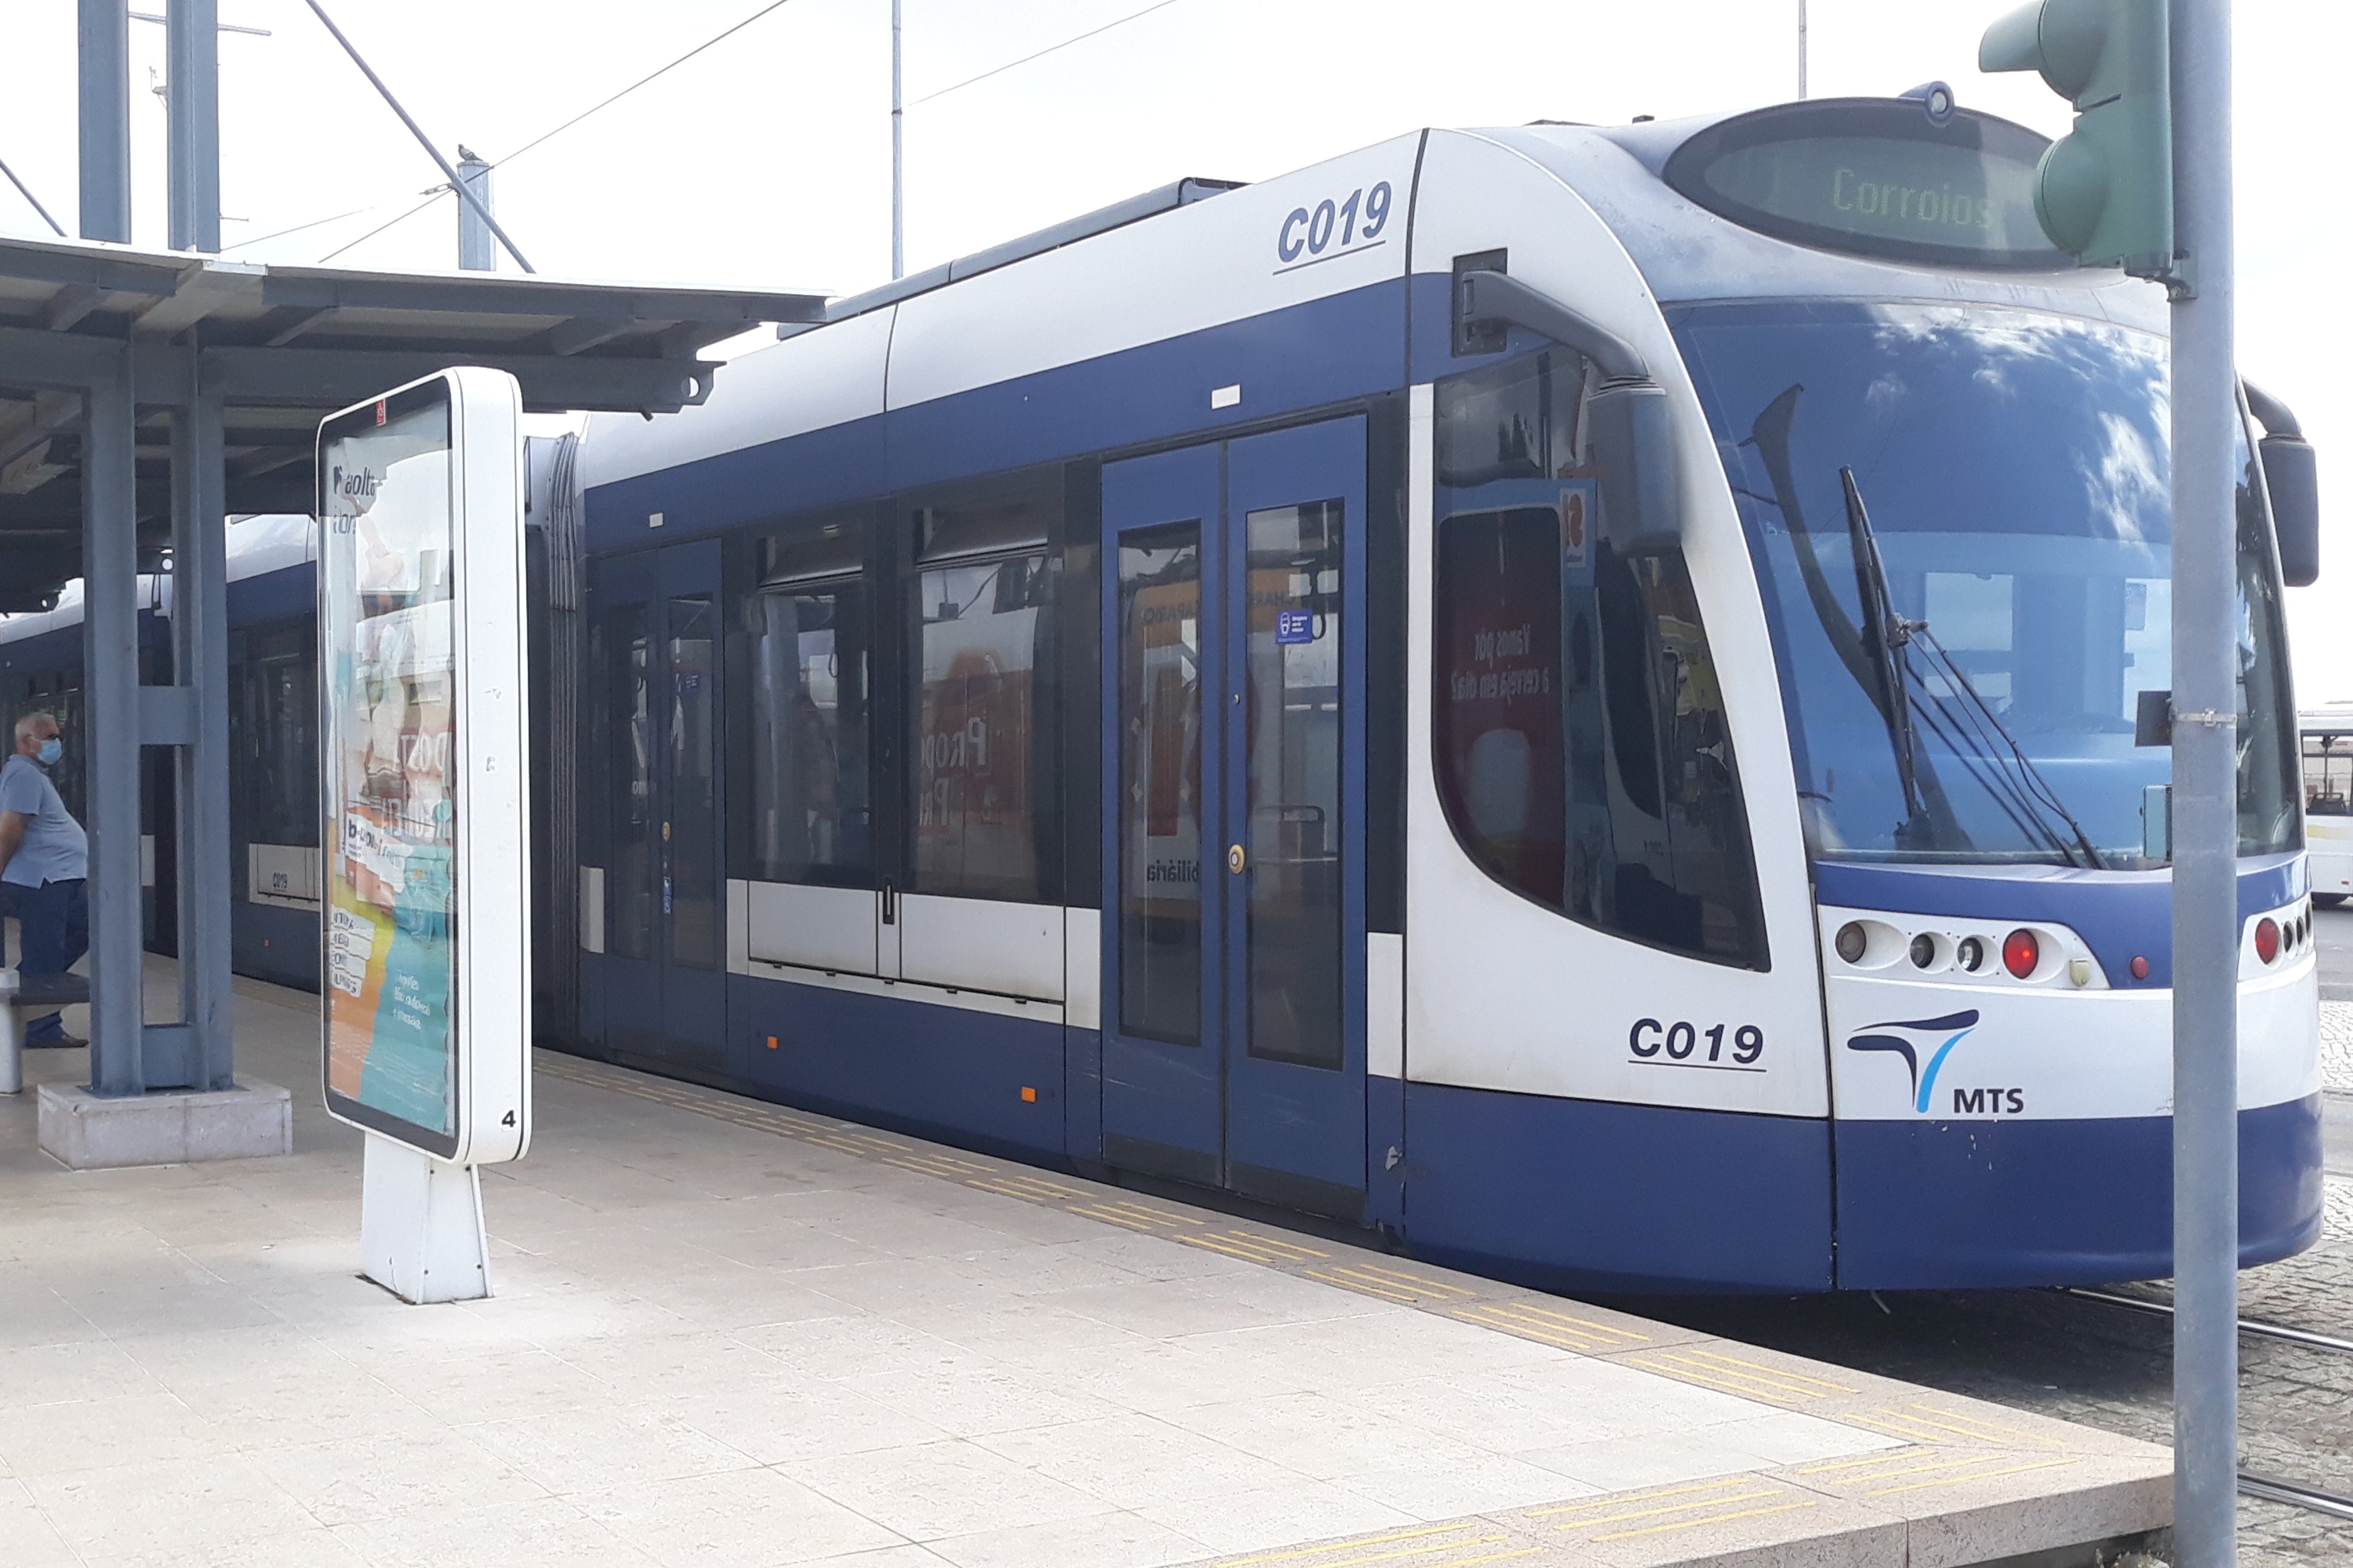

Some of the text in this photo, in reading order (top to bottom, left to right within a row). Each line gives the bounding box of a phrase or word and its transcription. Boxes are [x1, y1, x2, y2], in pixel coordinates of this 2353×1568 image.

[1833, 167, 1996, 228] Corroios
[1278, 181, 1392, 262] C019
[1629, 1018, 1763, 1064] C019
[501, 1110, 517, 1128] 4
[1954, 1088, 2024, 1115] MTS
